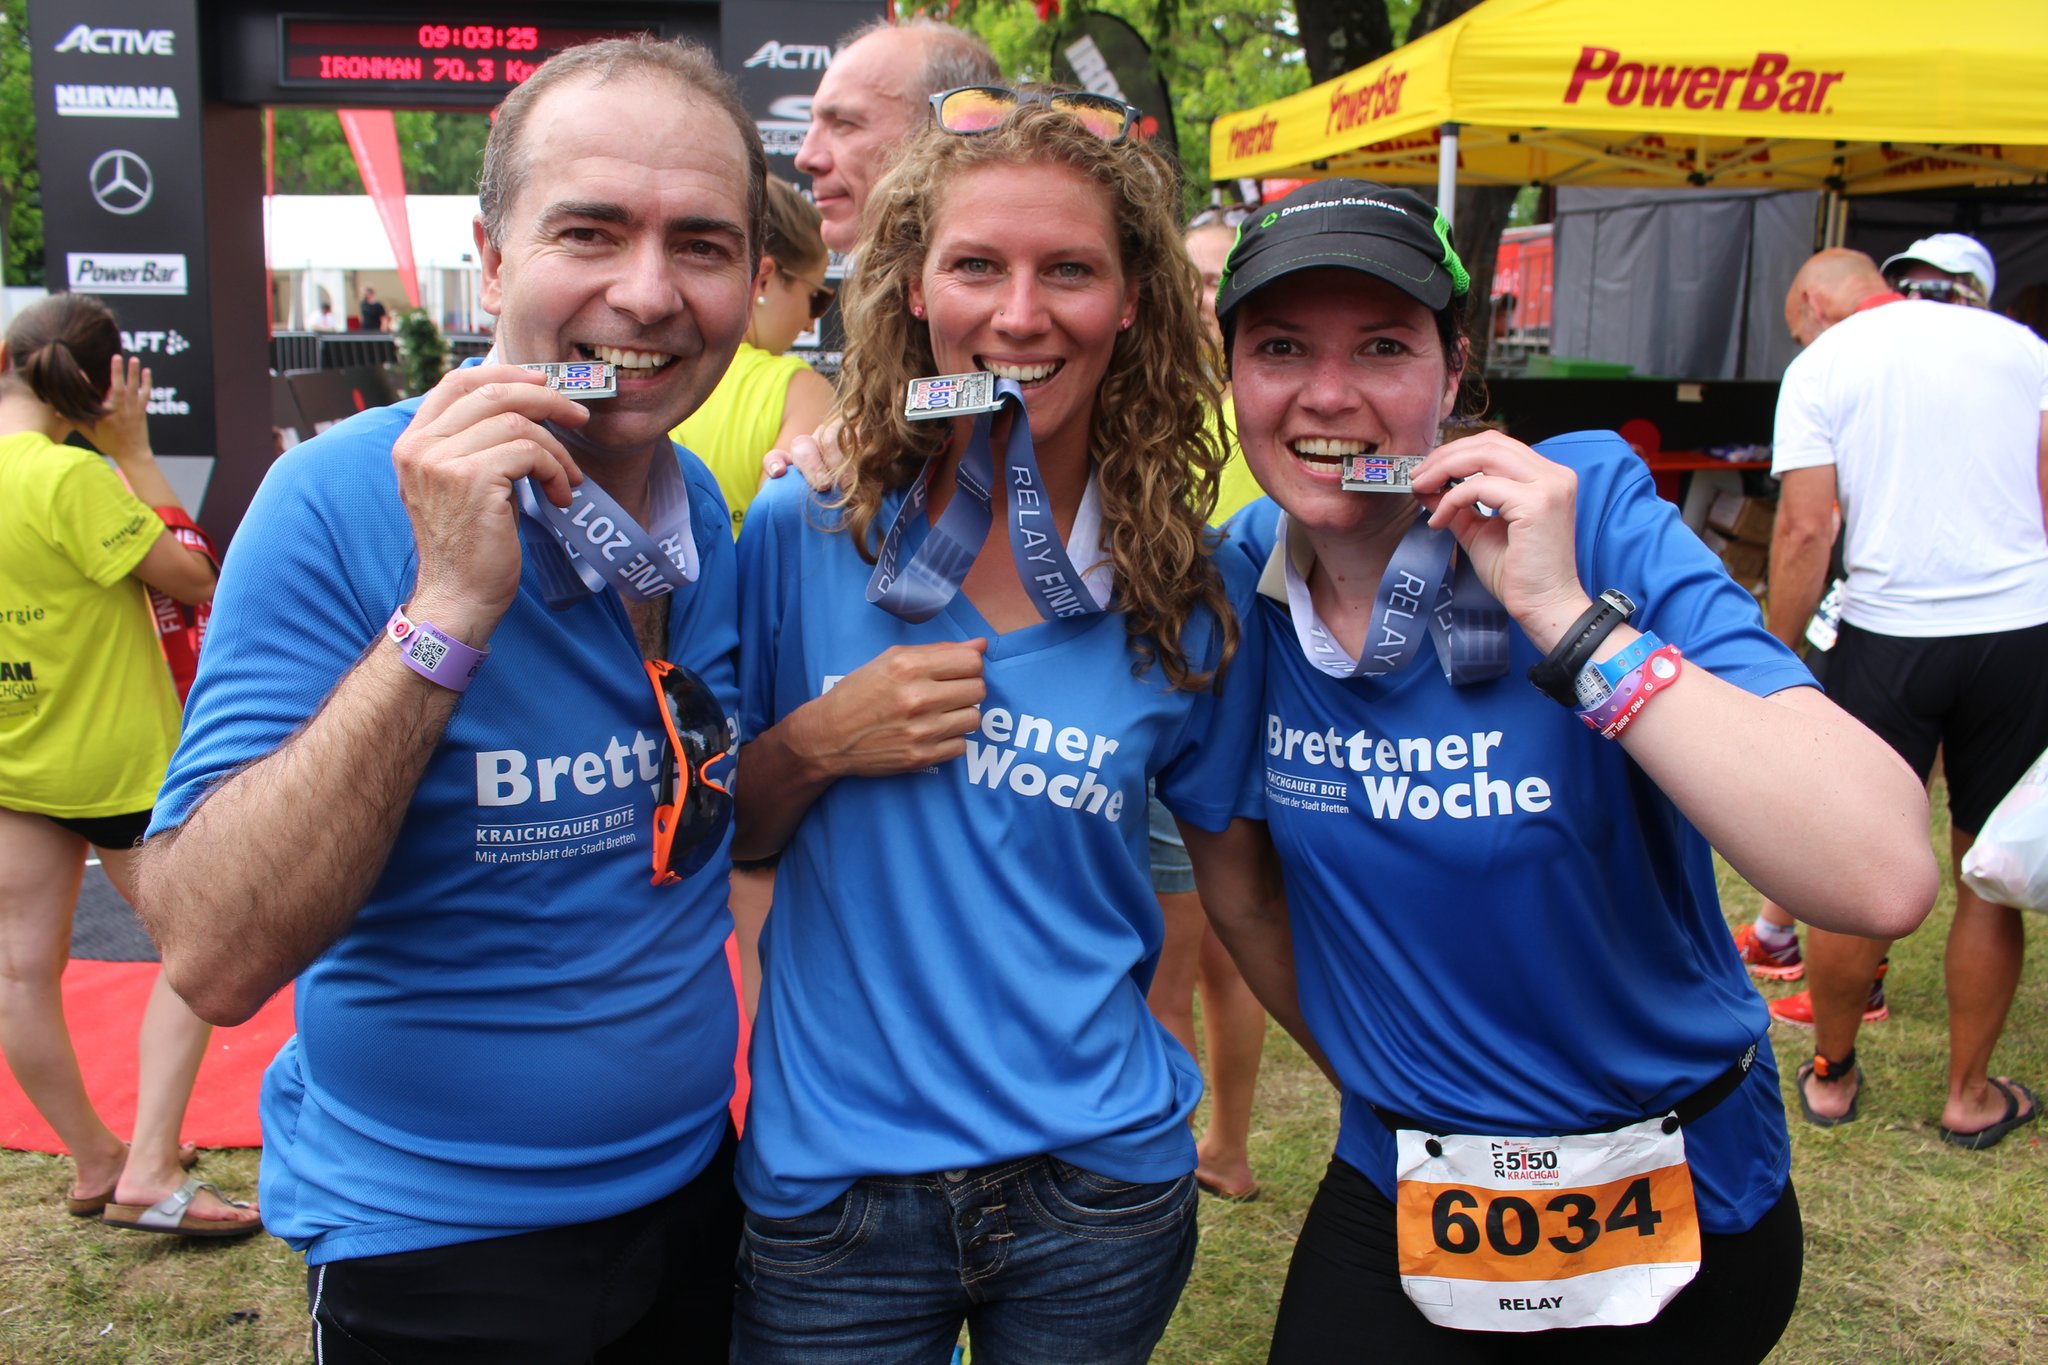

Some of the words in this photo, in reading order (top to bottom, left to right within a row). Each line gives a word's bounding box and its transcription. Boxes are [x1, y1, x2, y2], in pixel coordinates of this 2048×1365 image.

[54, 24, 176, 55] ACTIVE
[418, 25, 538, 50] 09:03:25
[320, 56, 422, 80] IRONMAN
[433, 58, 494, 82] 70.3
[743, 40, 834, 70] ACTIV
[1564, 46, 1844, 115] PowerBar
[1326, 64, 1408, 136] PowerBar
[1228, 118, 1279, 162] PowerBar
[1281, 200, 1340, 217] Dresdner
[77, 259, 178, 282] PowerBar
[120, 331, 166, 353] AFT
[145, 400, 190, 415] oche
[1010, 465, 1058, 565] RELAY
[1035, 572, 1088, 619] FINIS
[618, 552, 675, 600] UNE
[1373, 569, 1427, 667] RELAY
[1630, 696, 1645, 713] PRO
[981, 705, 1120, 770] ener
[1267, 713, 1503, 773] Brettener
[476, 730, 662, 807] Brett
[967, 739, 1124, 823] Woche
[1301, 800, 1319, 811] Stadt
[1321, 802, 1350, 814] Bretten
[1321, 784, 1347, 797] BOTE
[1362, 771, 1552, 821] Woche
[476, 818, 600, 842] KRAICHGAUER
[605, 808, 635, 829] BOTE
[475, 850, 497, 863] Mit
[500, 844, 559, 863] Amtsblatt
[561, 847, 579, 859] der
[581, 840, 605, 856] Stadt
[606, 831, 636, 851] Bretten
[1491, 1142, 1505, 1178] 2017
[1507, 1170, 1559, 1180] KRAICHGAU
[1431, 1177, 1663, 1257] 6034
[1499, 1295, 1563, 1311] RELAY
